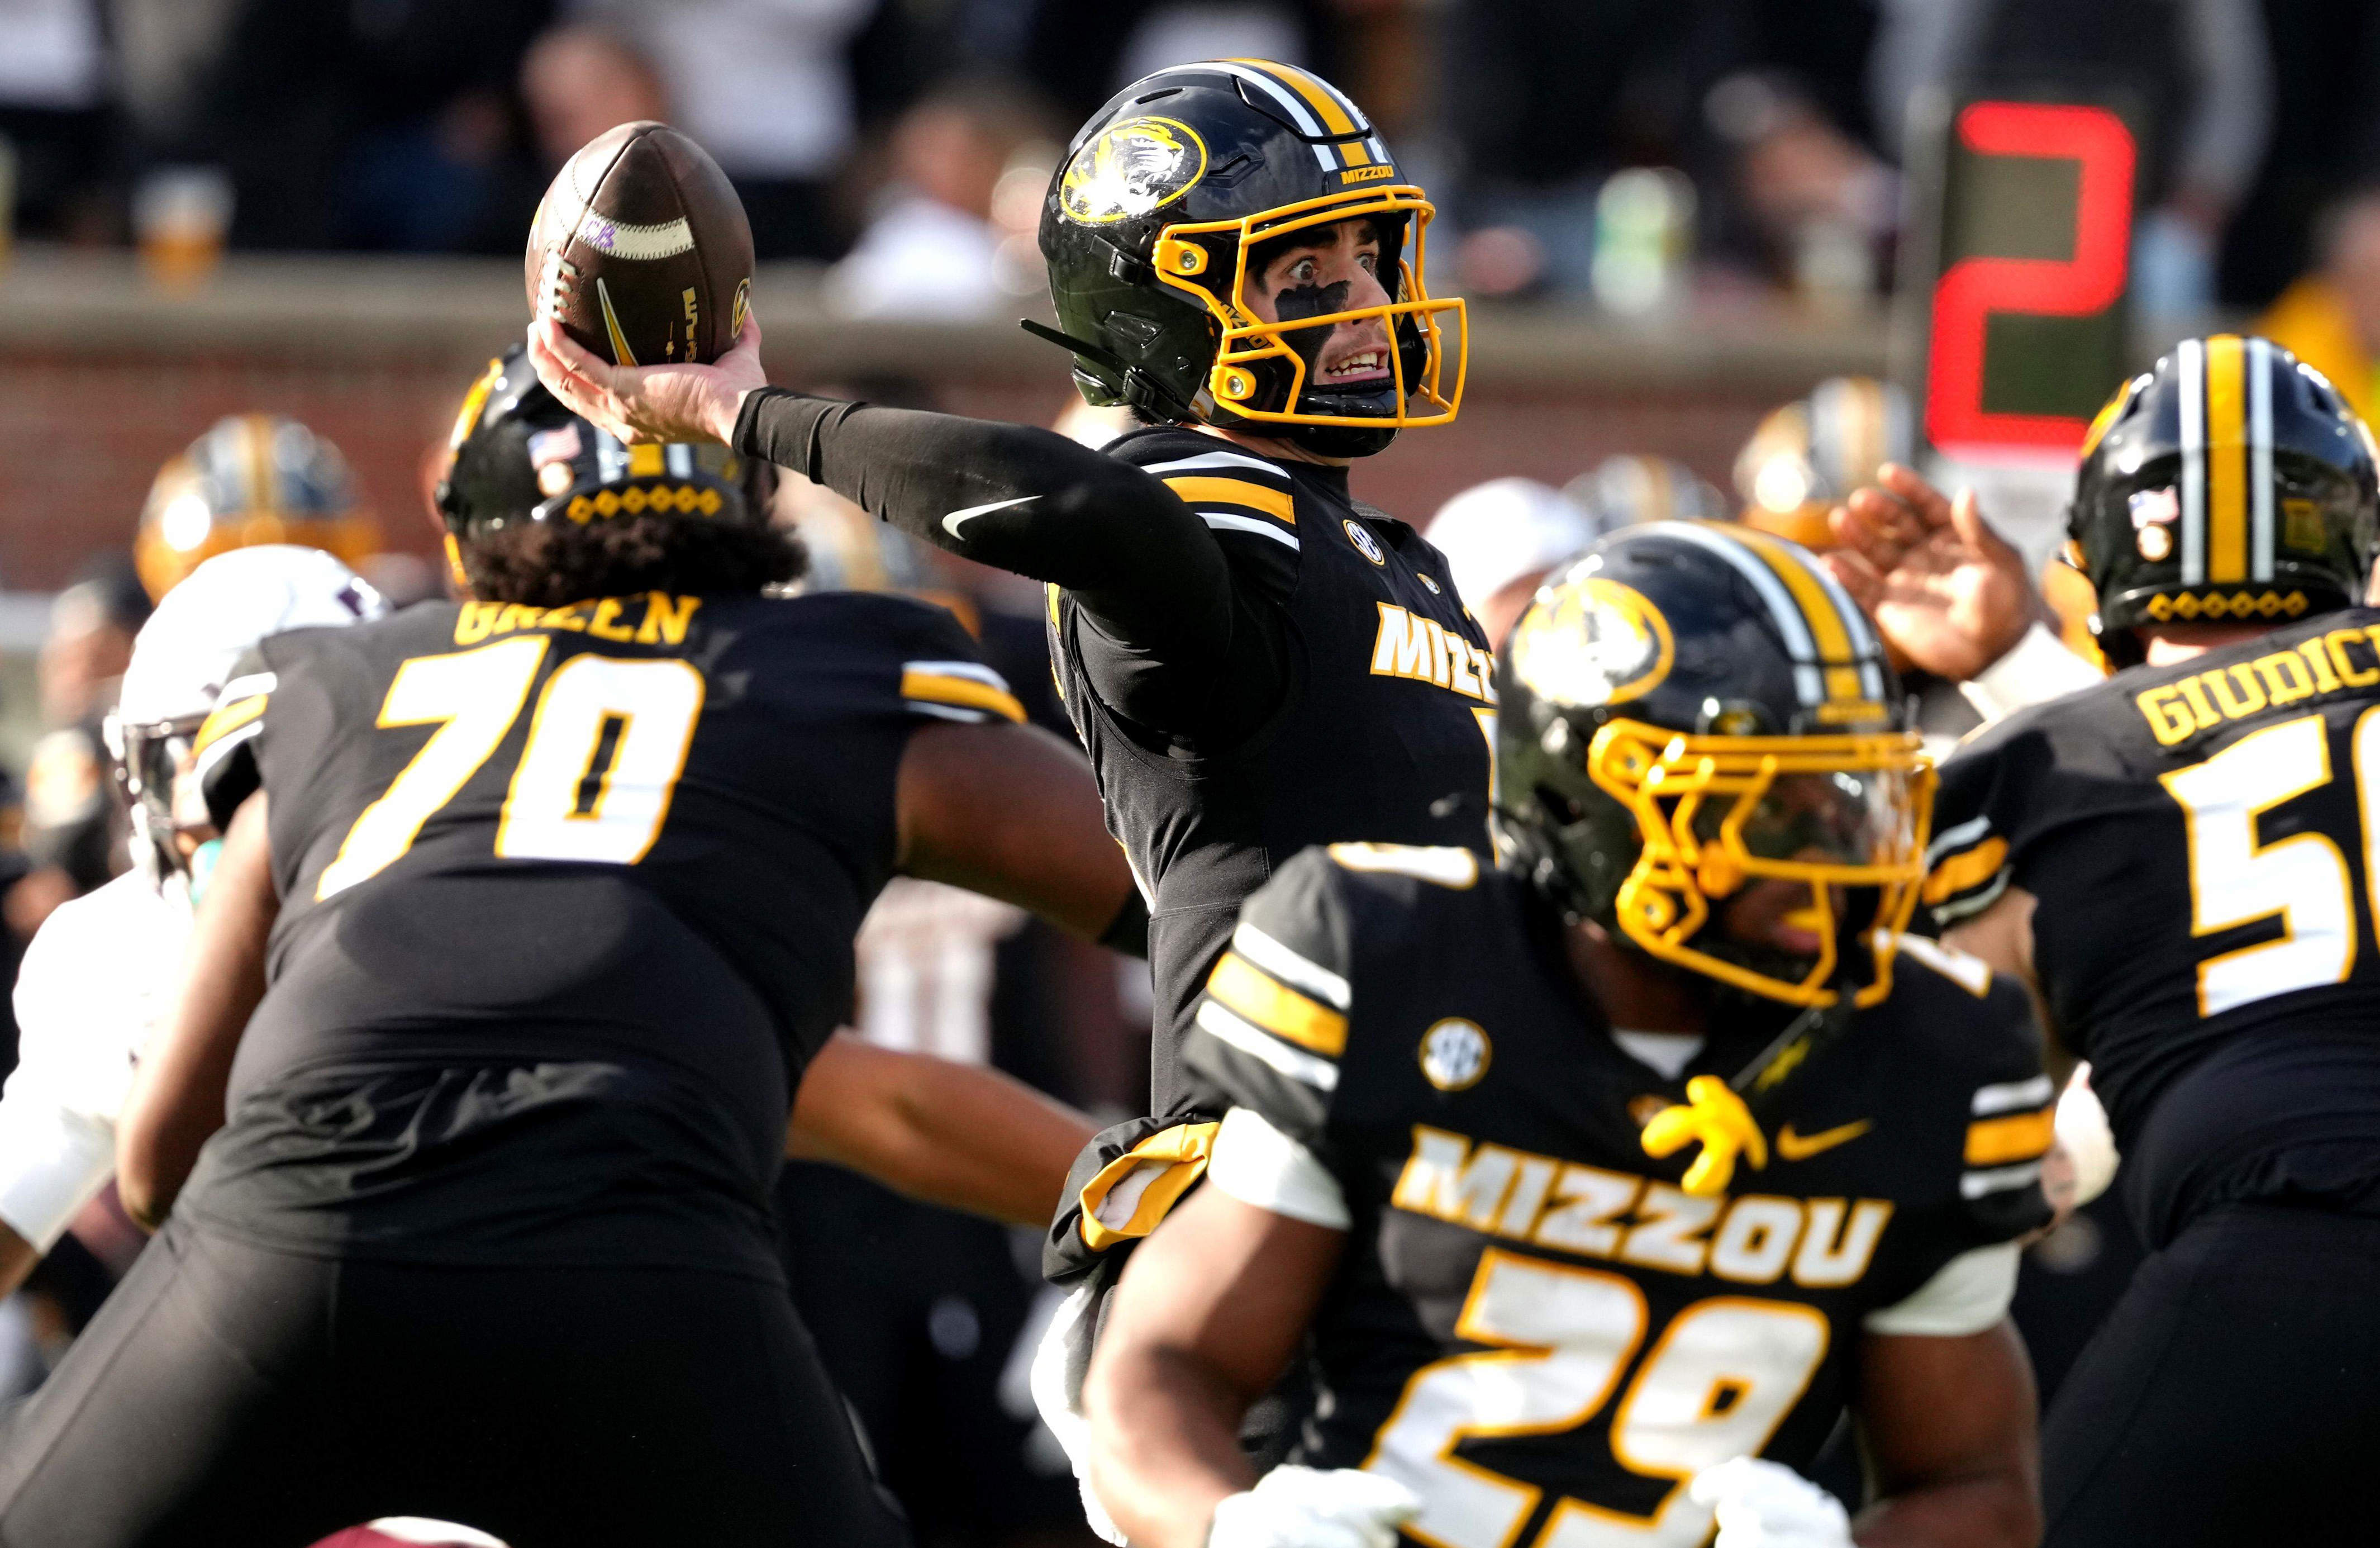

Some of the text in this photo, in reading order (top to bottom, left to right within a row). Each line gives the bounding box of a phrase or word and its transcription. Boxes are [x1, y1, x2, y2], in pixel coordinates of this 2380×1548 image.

[1340, 165, 1394, 185] MIZZOU
[1925, 101, 2136, 472] 2
[315, 634, 706, 902] 70
[1369, 600, 1500, 704] MIZZ
[2157, 704, 2380, 1018] 5
[1391, 1118, 1895, 1287] MIZZOU
[1359, 1246, 1831, 1548] 29
